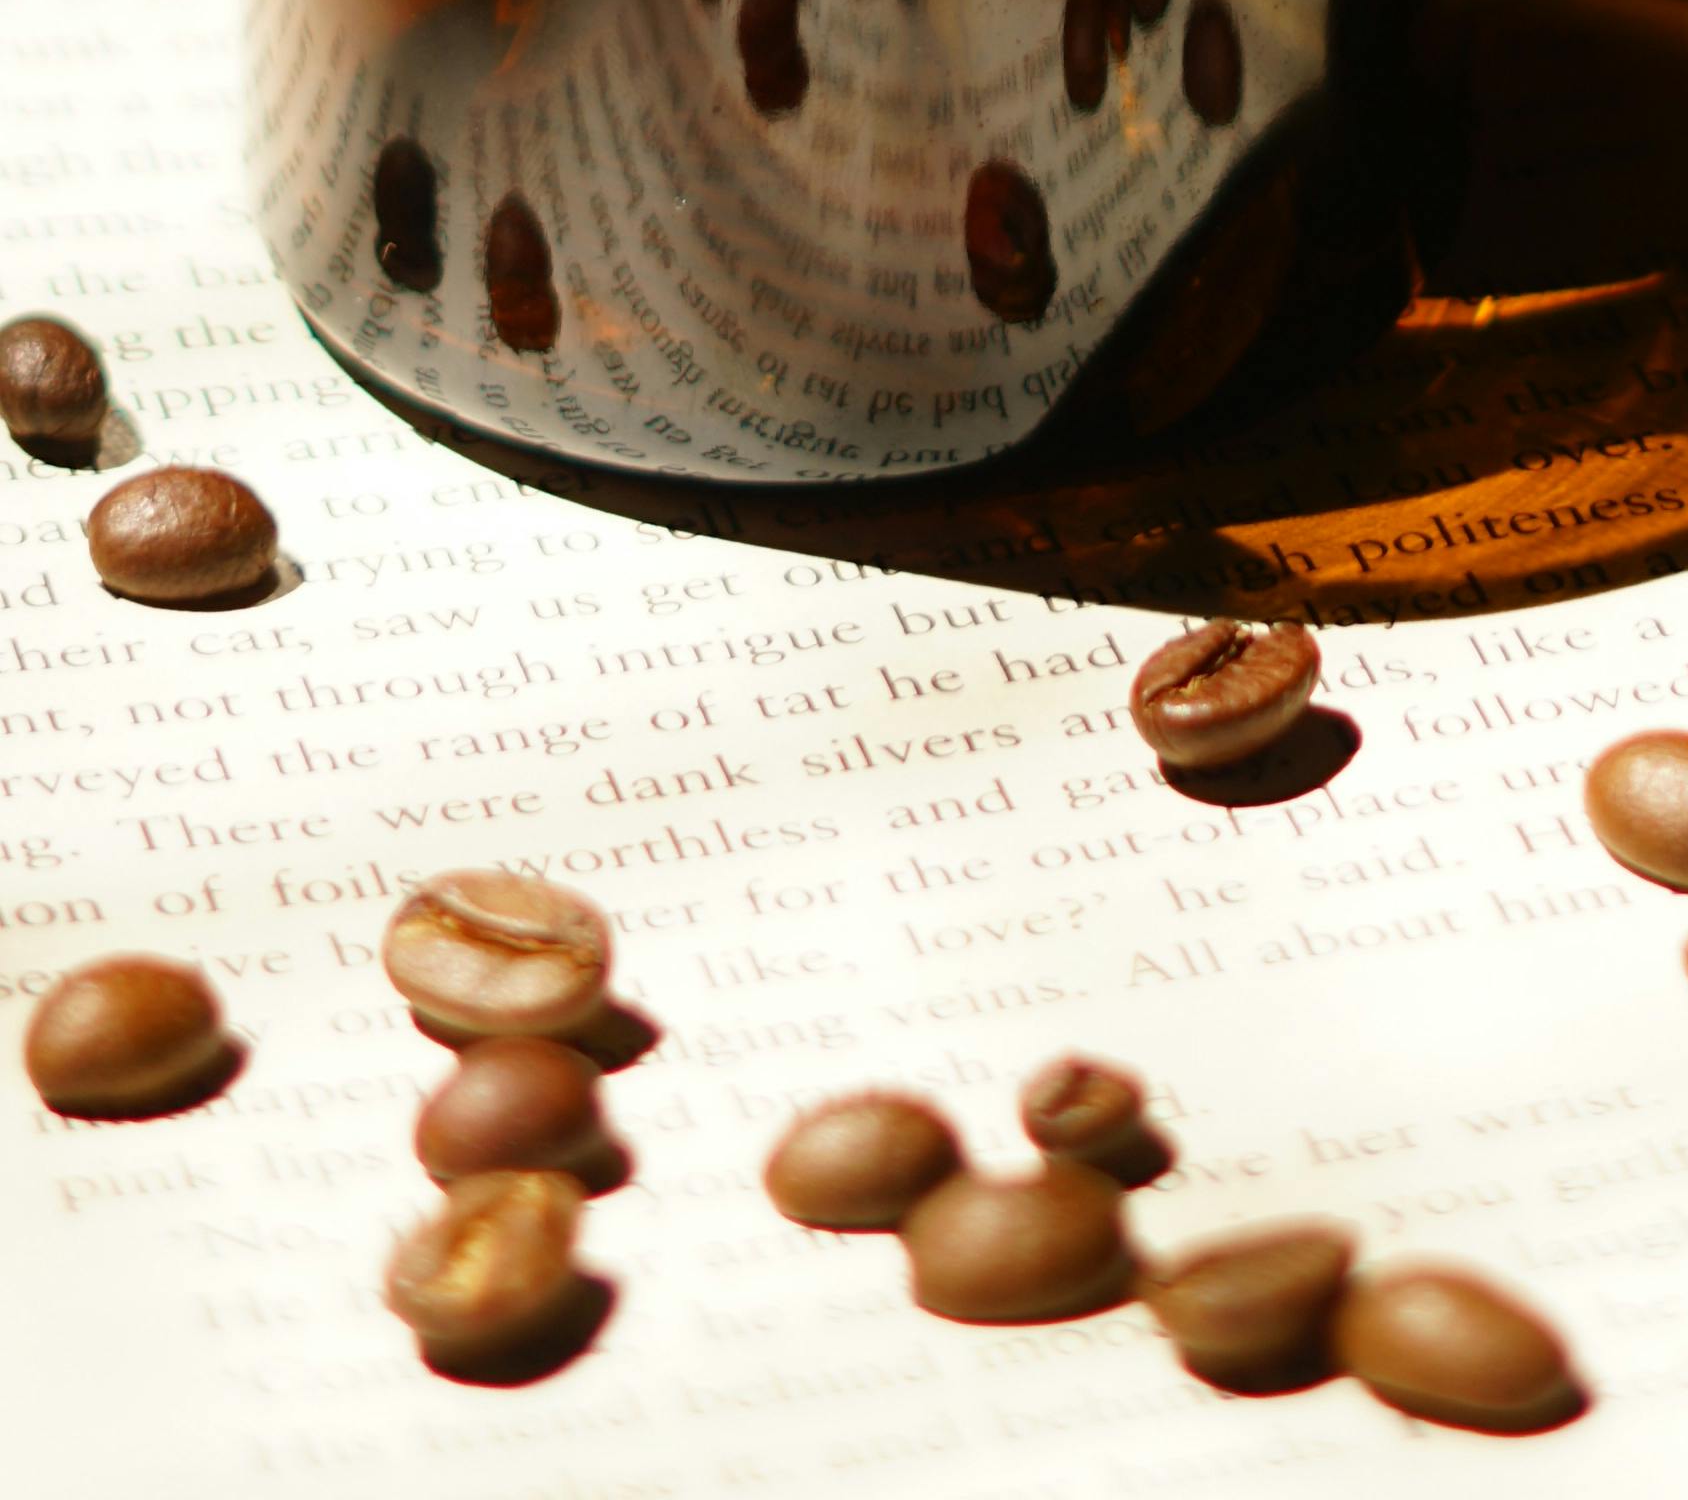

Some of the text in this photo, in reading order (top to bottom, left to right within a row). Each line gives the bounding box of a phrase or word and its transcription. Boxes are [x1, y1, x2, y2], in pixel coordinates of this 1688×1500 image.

[172, 312, 277, 350] the
[188, 622, 316, 656] car,
[350, 604, 484, 644] saw
[526, 590, 603, 621] us
[638, 570, 746, 618] get
[1512, 424, 1674, 472] over.
[125, 692, 246, 726] not
[272, 650, 561, 716] through
[588, 618, 867, 680] intrigue
[890, 594, 1014, 638] but
[268, 738, 382, 778] the
[416, 712, 613, 764] range
[647, 688, 720, 734] of
[751, 678, 854, 722] tat
[874, 662, 967, 704] he
[990, 630, 1128, 686] had
[114, 811, 335, 854] There
[370, 784, 546, 832] were
[582, 752, 764, 808] dank
[798, 720, 1024, 780] silvers
[1466, 622, 1602, 668] like
[1634, 614, 1674, 642] a
[152, 872, 226, 918] of
[494, 816, 844, 882] worthless
[884, 774, 1018, 832] and
[694, 942, 864, 992] like,
[1162, 874, 1254, 914] he
[1298, 834, 1472, 892] said.
[740, 874, 850, 918] for
[880, 850, 1000, 900] the
[876, 878, 1632, 1032] veins. All about him
[1294, 1118, 1428, 1170] her
